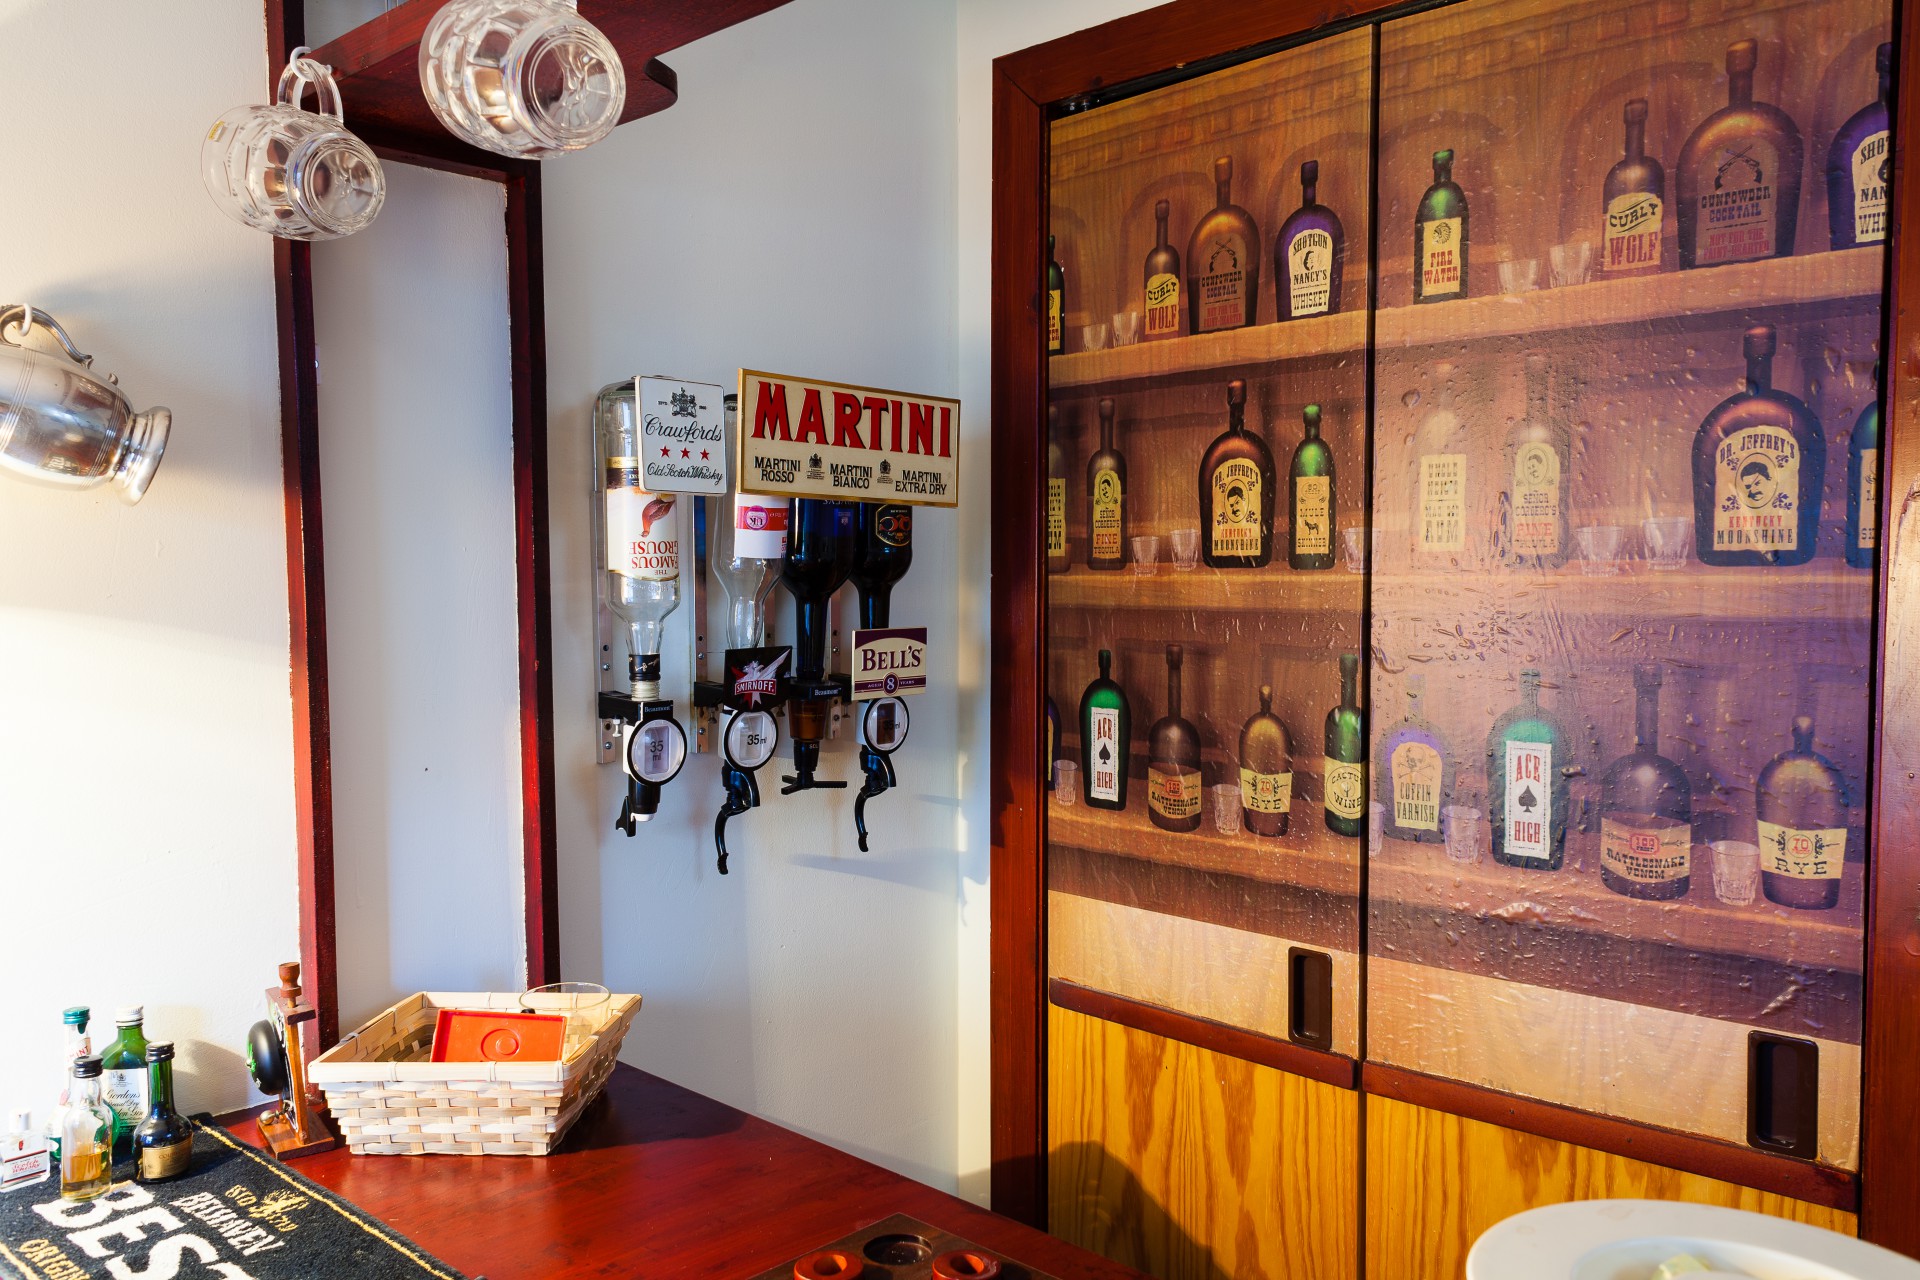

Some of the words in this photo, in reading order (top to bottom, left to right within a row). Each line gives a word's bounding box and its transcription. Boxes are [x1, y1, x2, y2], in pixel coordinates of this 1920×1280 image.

[1701, 185, 1771, 209] GUNPOWDER
[1609, 203, 1659, 228] CURLY
[1709, 202, 1762, 223] COCKTAIL
[1293, 233, 1328, 256] SHOTGUN
[1609, 231, 1659, 266] WOLF
[1430, 249, 1453, 268] FIRE
[1293, 269, 1328, 286] NANCY'S
[1424, 266, 1459, 285] WATER
[1147, 281, 1177, 301] CURLY
[1292, 290, 1328, 311] WHISKEY
[1148, 304, 1177, 331] WOLF
[751, 380, 951, 459] MARTINI
[1719, 443, 1736, 465] DR.
[1739, 433, 1795, 460] JEFFREY'S
[647, 462, 664, 476] Old
[664, 464, 691, 478] Scotch
[689, 465, 723, 486] Whisky
[754, 456, 801, 473] MARTINI
[829, 462, 873, 479] MARTINI
[760, 470, 795, 484] ROSSO
[832, 475, 870, 490] BIANCO
[902, 470, 942, 484] MARTINI
[895, 481, 927, 494] EXTRA
[928, 483, 948, 496] DRY
[1728, 515, 1783, 527] KENTUCKY
[1095, 533, 1118, 545] FINE
[1213, 538, 1259, 551] MOONSHINE
[1716, 528, 1794, 545] MOONSHINE
[861, 645, 923, 672] BELL'S
[736, 680, 775, 693] SMIRNOFF
[887, 677, 895, 690] 8
[1096, 717, 1113, 741] ACE
[650, 740, 664, 753] 35
[1515, 753, 1541, 783] ACE
[1096, 771, 1113, 790] HIGH
[1250, 795, 1282, 810] RYE
[1396, 801, 1435, 823] VARNISH
[1514, 820, 1541, 844] HIGH
[1606, 847, 1685, 869] RATTLESNAKE
[1774, 857, 1828, 875] RYE
[1626, 865, 1665, 879] VENOM
[31, 1180, 261, 1280] BES
